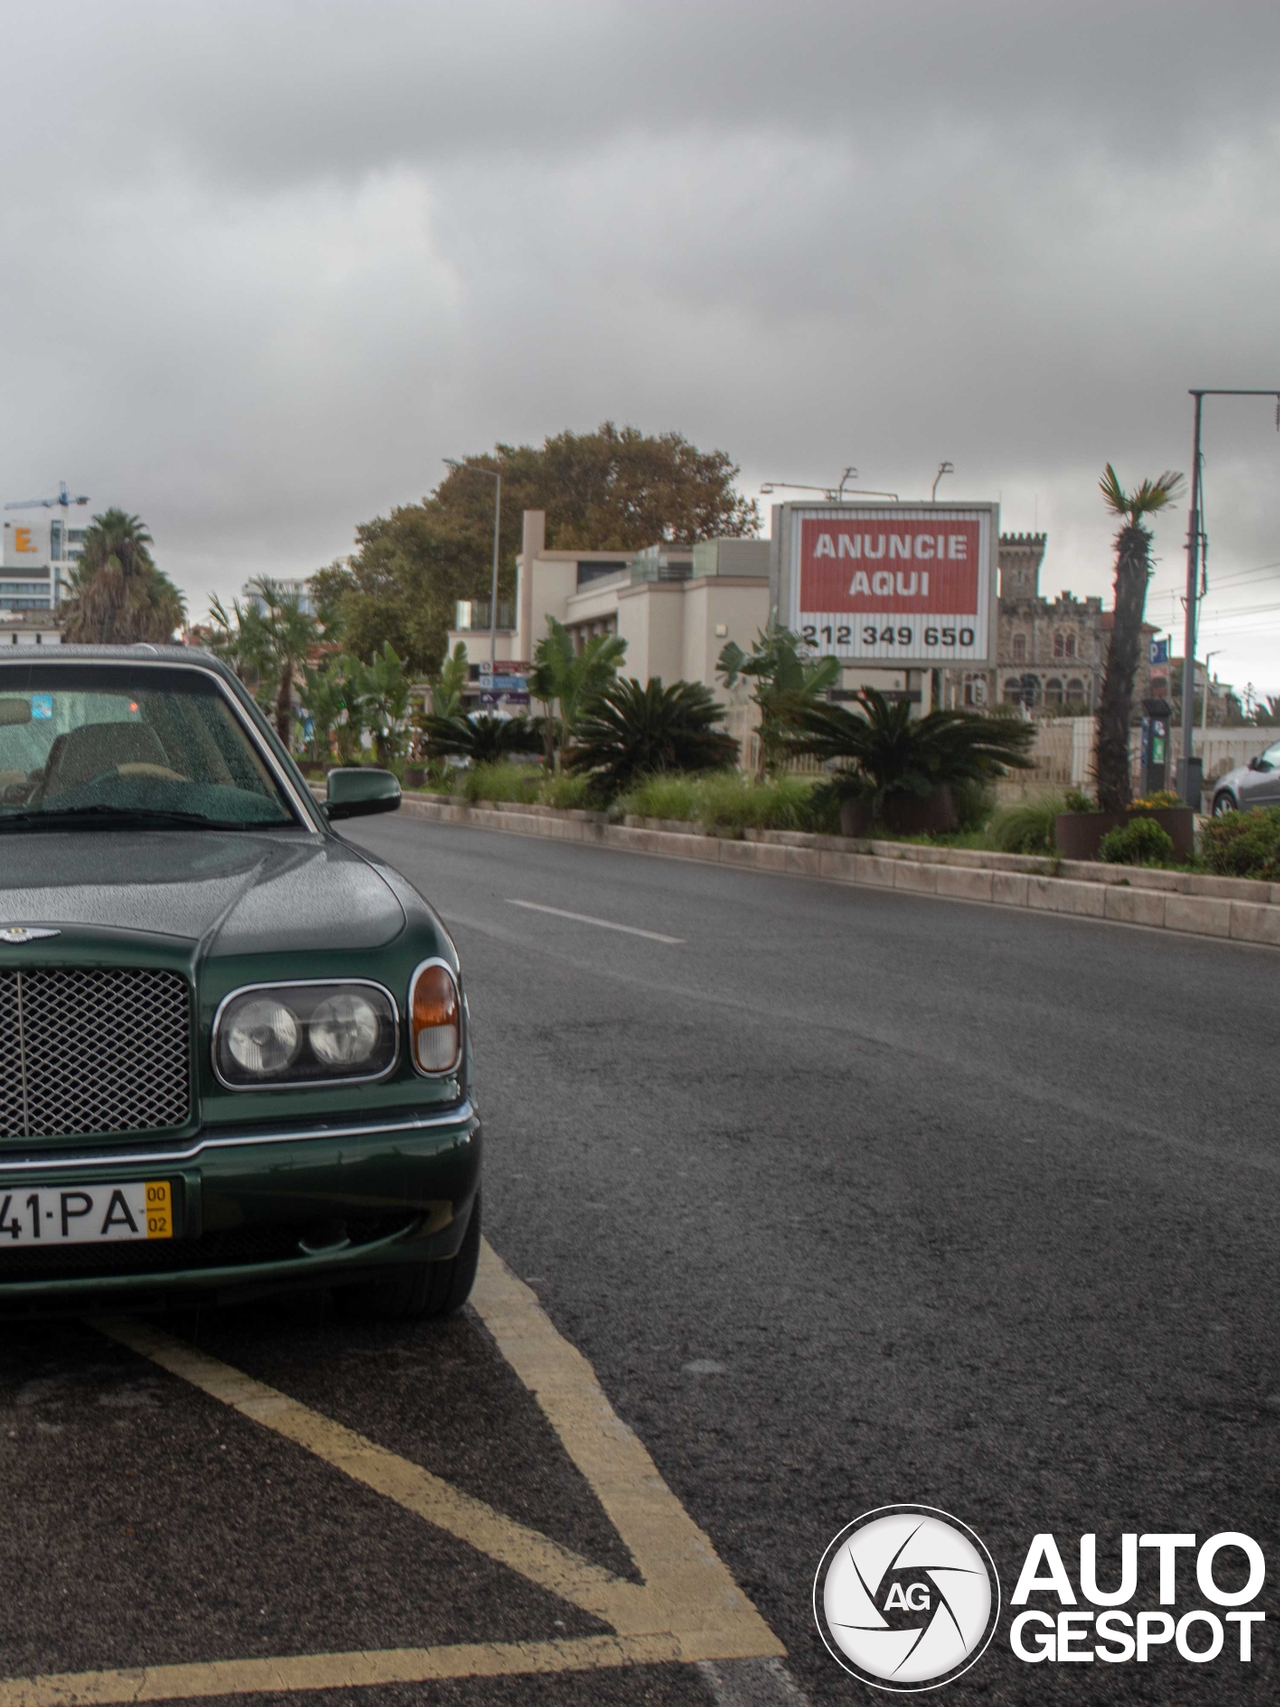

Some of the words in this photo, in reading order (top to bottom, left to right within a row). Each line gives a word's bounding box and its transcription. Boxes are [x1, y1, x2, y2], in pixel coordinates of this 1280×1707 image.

[813, 534, 967, 559] ANUNCIE
[849, 571, 930, 596] AQUI
[803, 625, 851, 645] 212
[863, 626, 913, 645] 349
[924, 627, 975, 646] 650
[147, 1187, 166, 1202] 00
[148, 1217, 167, 1232] 02
